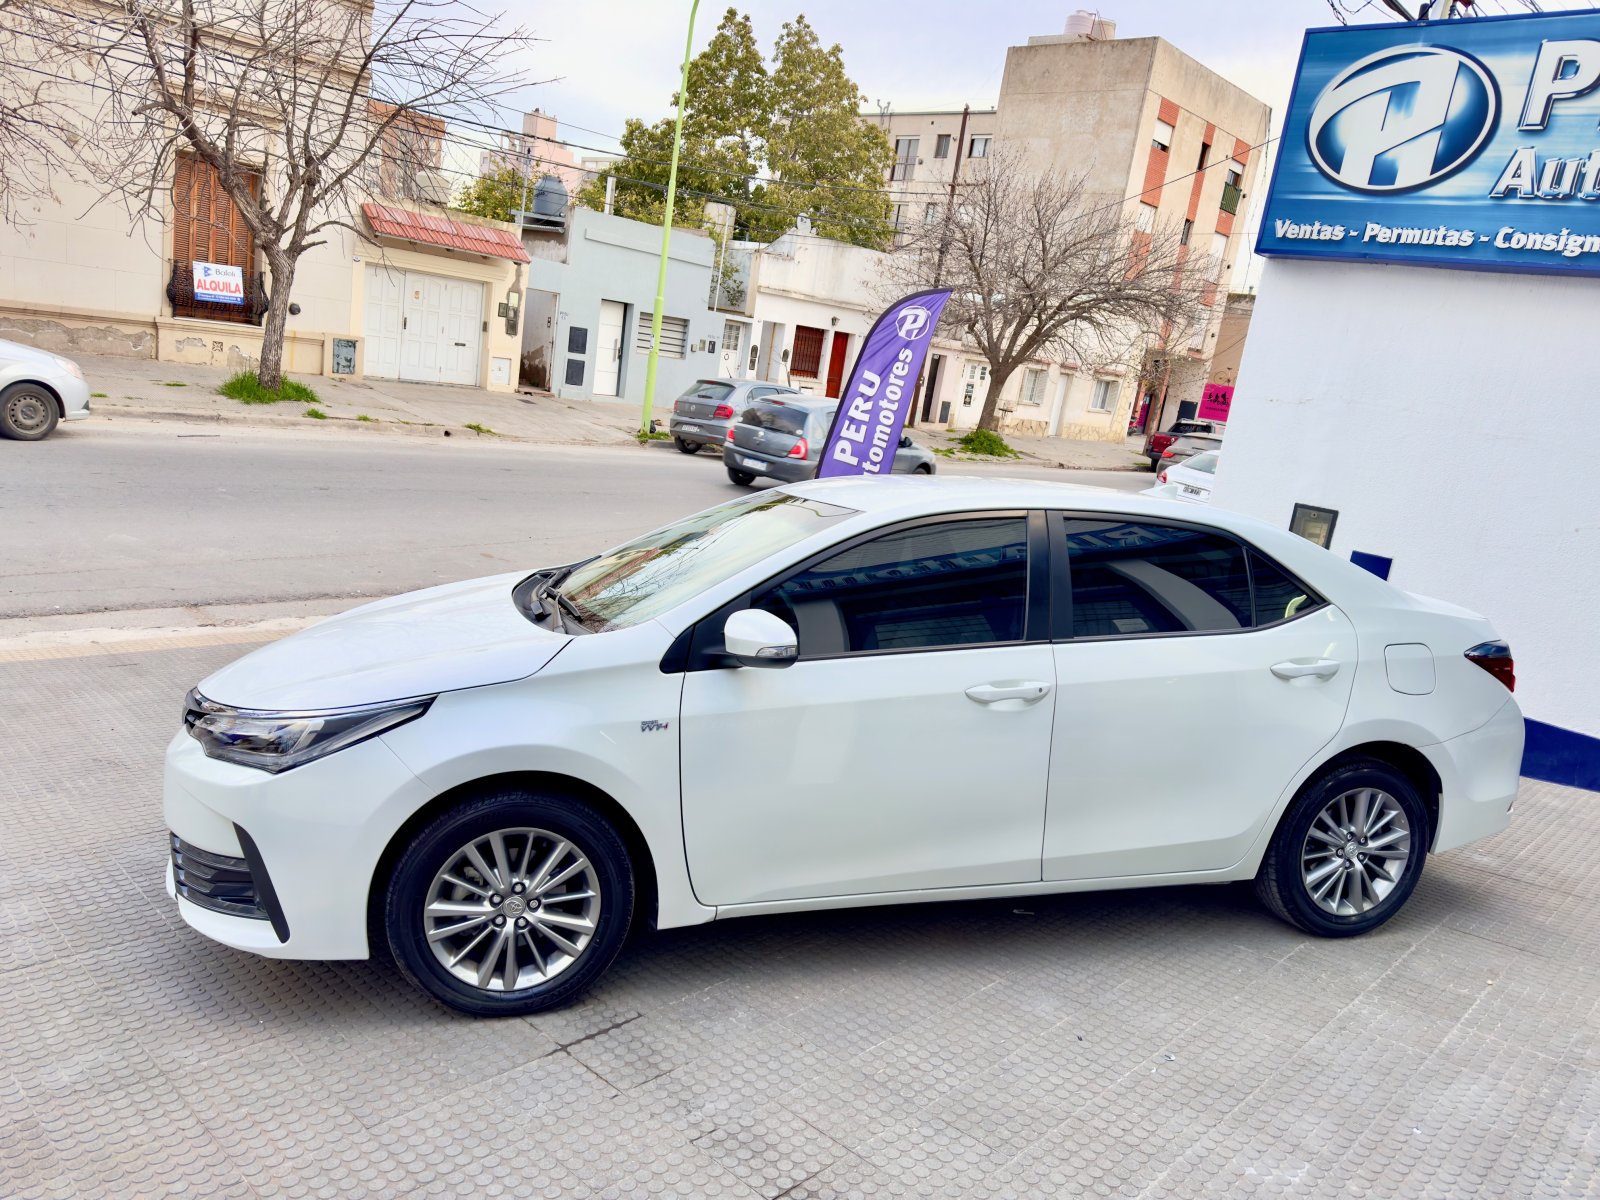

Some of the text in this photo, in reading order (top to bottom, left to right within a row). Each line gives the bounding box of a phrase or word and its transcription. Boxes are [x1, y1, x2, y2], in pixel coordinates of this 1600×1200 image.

[1275, 218, 1346, 242] Ventas
[1362, 221, 1476, 248] Permutas
[197, 279, 241, 294] ALQUILA
[833, 369, 881, 466] PERU
[862, 347, 913, 475] tomotores
